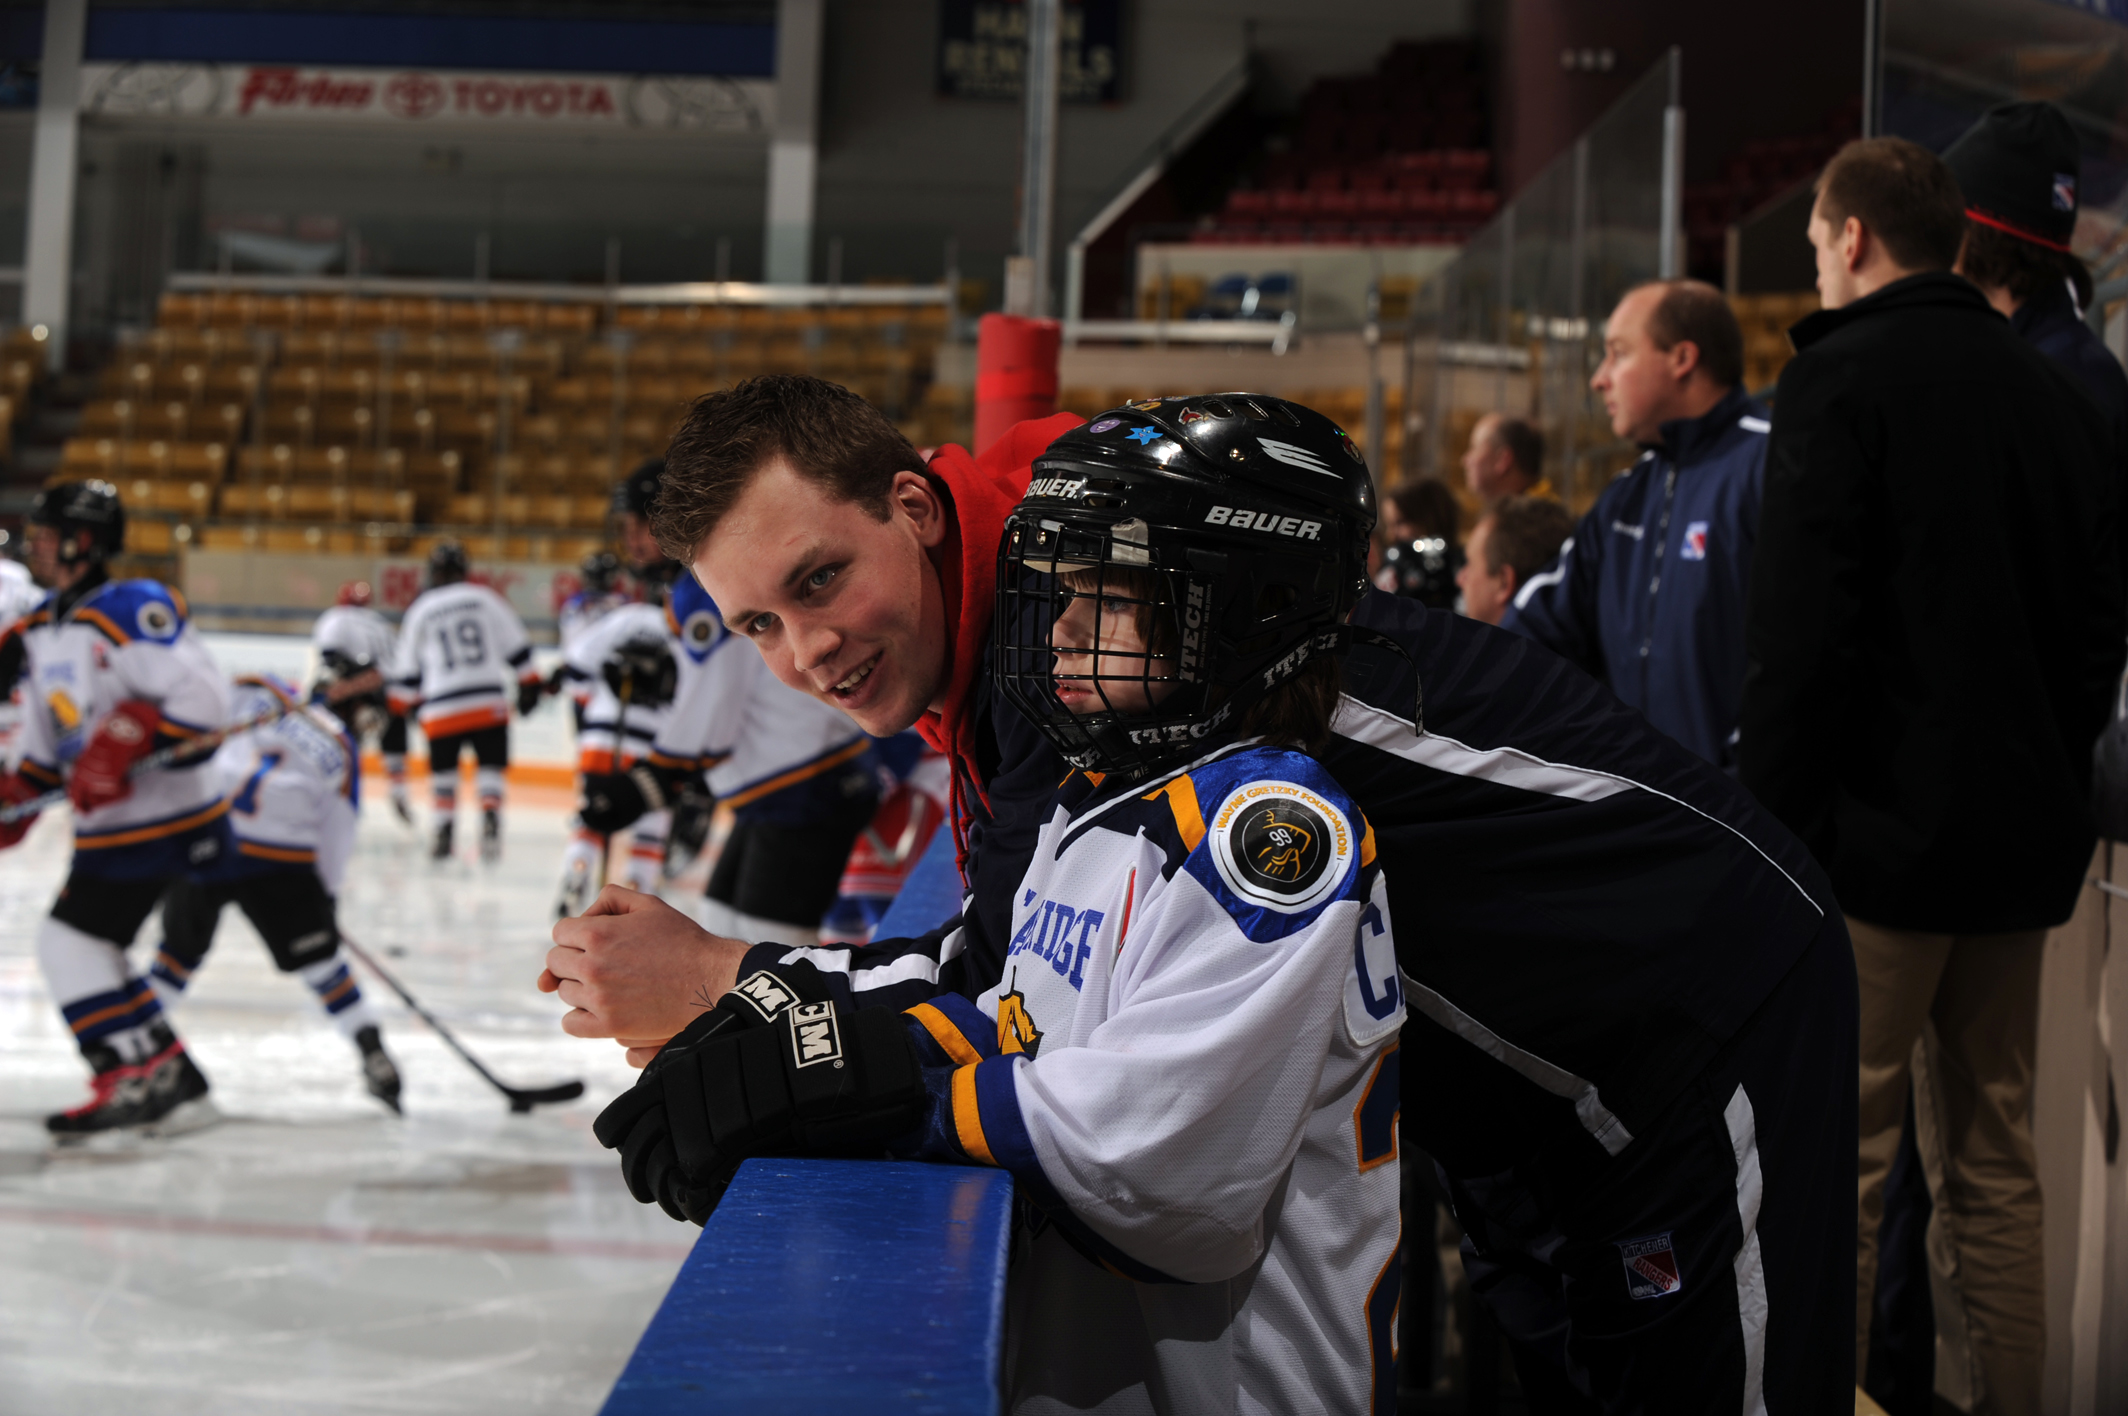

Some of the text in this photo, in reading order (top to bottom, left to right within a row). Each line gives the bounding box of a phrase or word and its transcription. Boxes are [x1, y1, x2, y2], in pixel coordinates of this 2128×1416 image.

[453, 78, 615, 118] TOYOTA
[440, 618, 485, 669] 19
[1179, 581, 1204, 683] ITECH
[1216, 785, 1347, 856] WAYNE GRETZKY FOUNDATION
[1268, 828, 1293, 847] 99
[1623, 1237, 1669, 1259] KITCHENER
[1632, 1257, 1673, 1291] RANGERS
